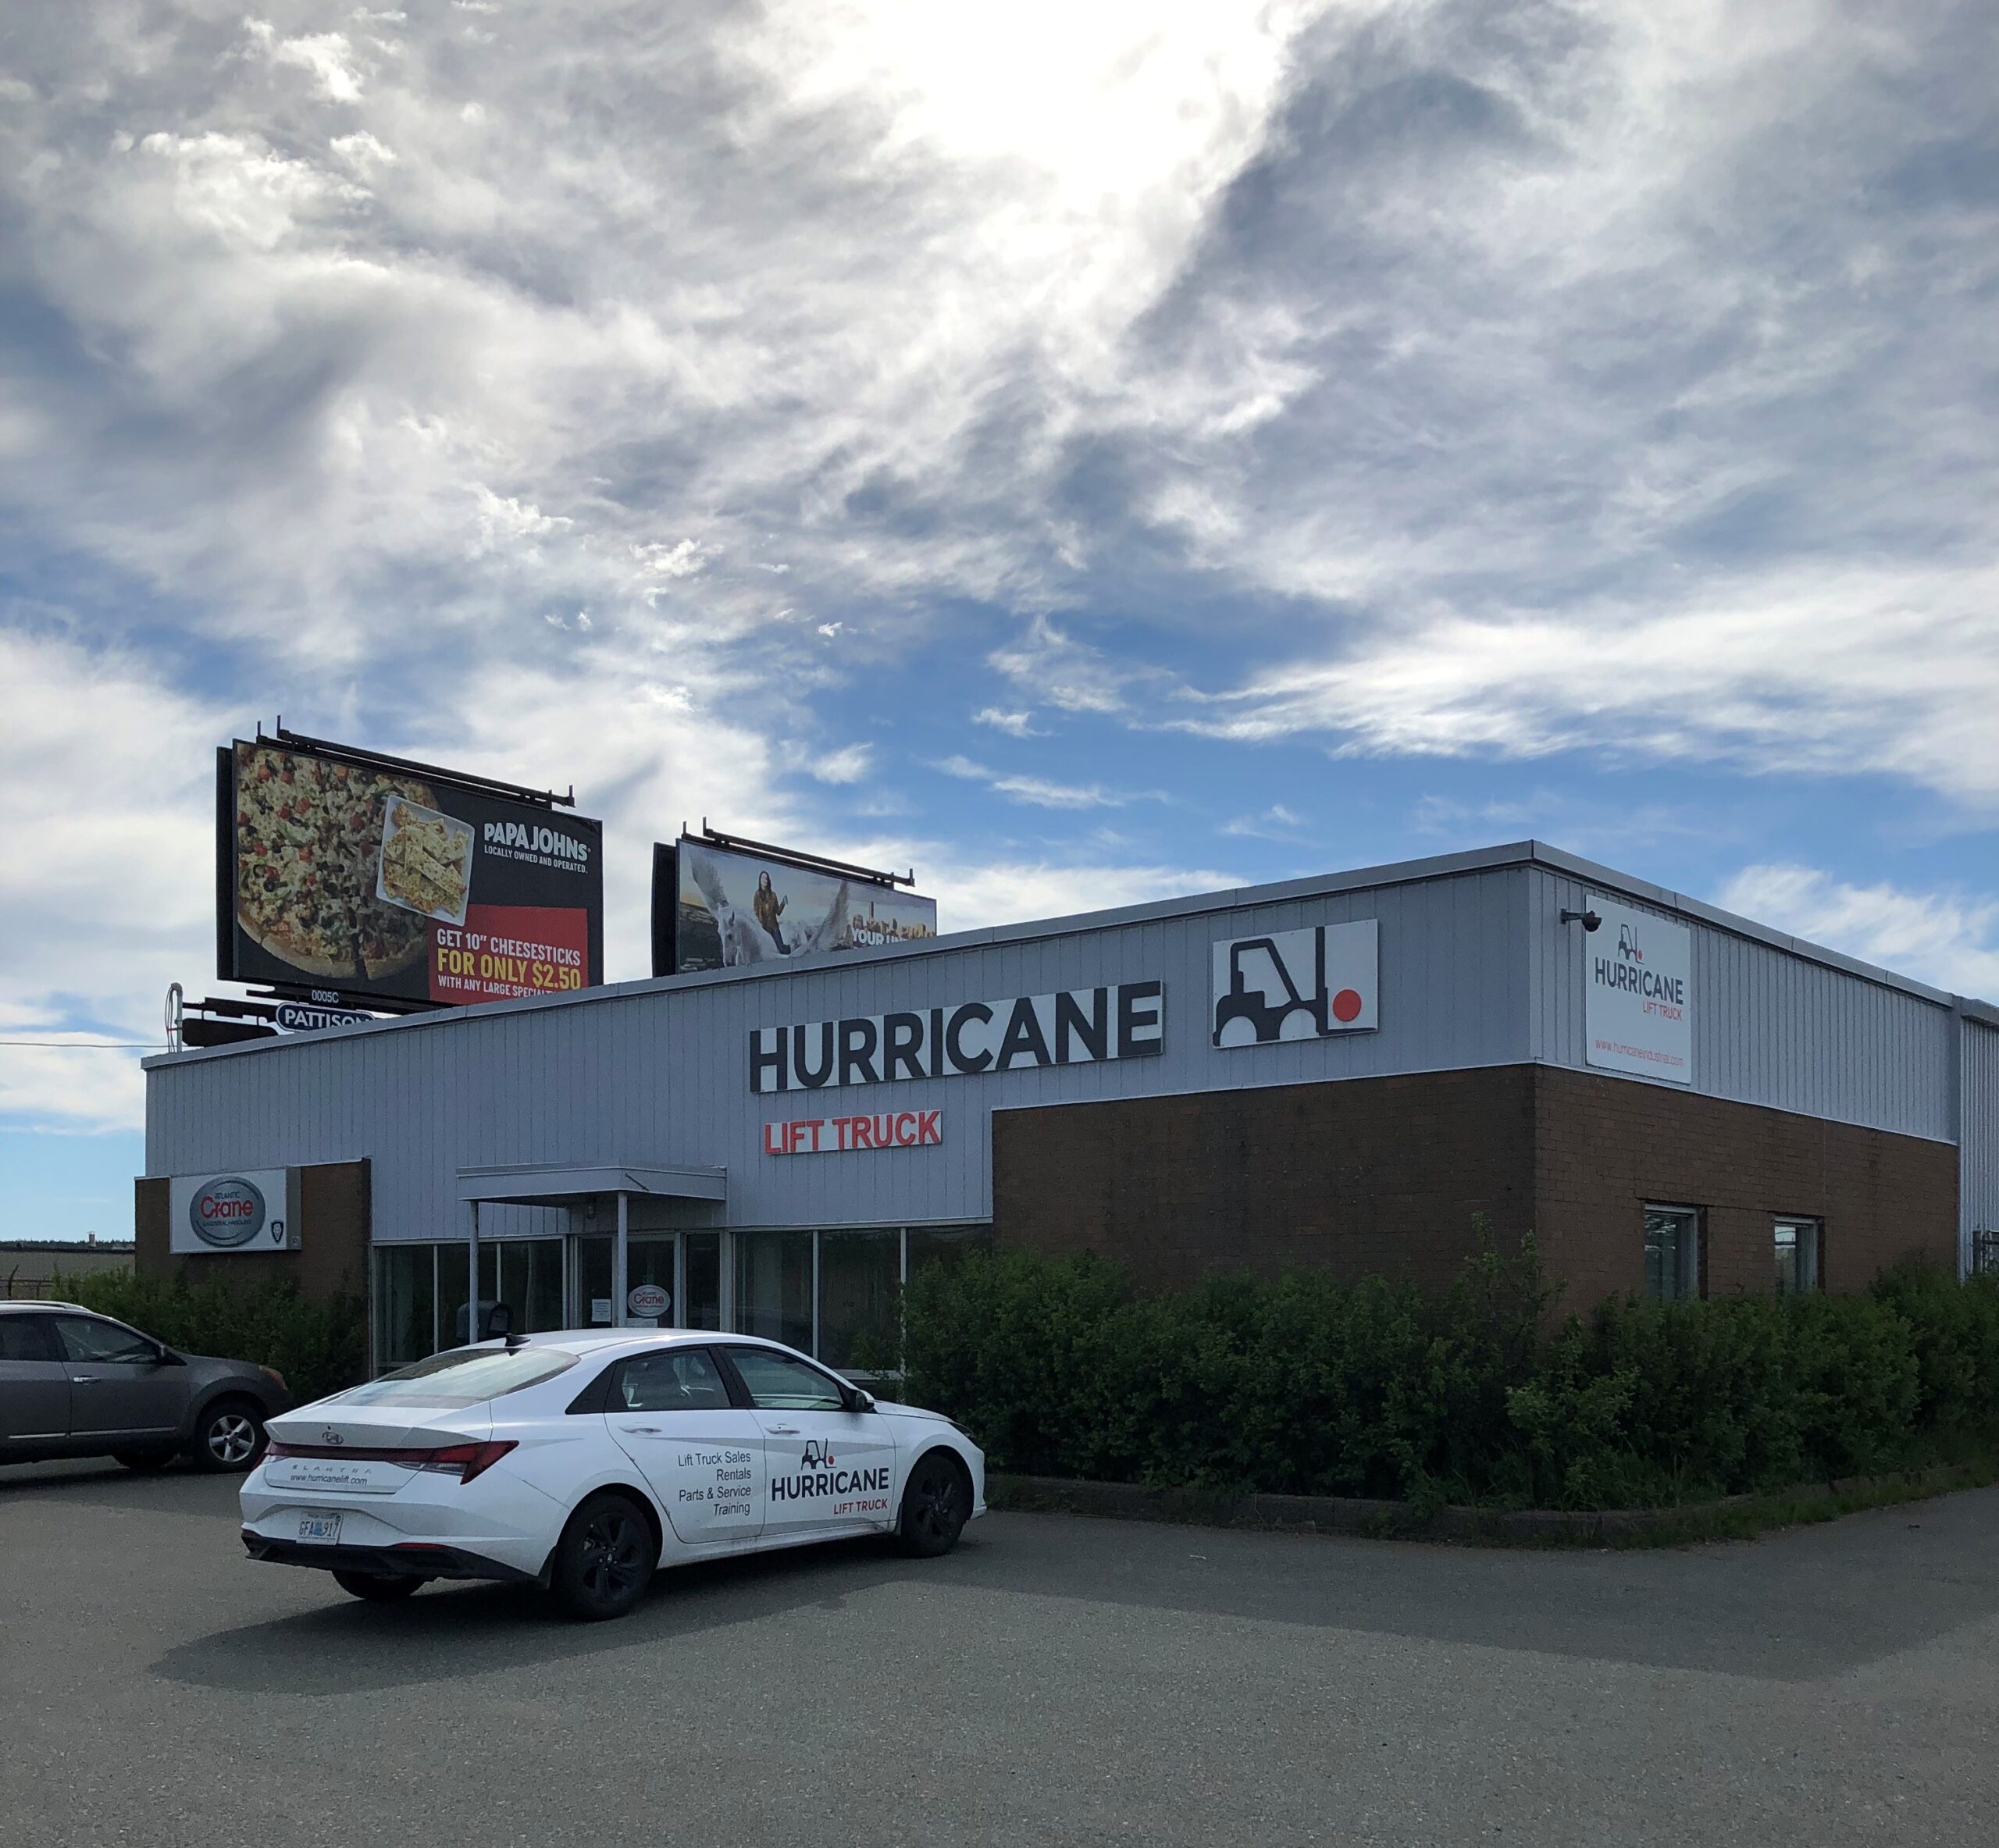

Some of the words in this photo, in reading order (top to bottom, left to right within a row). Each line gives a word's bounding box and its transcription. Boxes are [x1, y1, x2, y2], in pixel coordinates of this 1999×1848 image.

[484, 822, 530, 849] PAPA
[531, 826, 588, 861] JOHNS
[484, 845, 513, 858] LOCALLY
[514, 850, 538, 863] OWNED
[539, 856, 552, 867] AND
[553, 860, 588, 874] OPERATED.
[851, 927, 884, 945] YOUR
[437, 928, 462, 948] GET
[466, 932, 487, 950] 10"
[490, 936, 581, 966] CHEESESTICKS
[437, 947, 475, 976] FOR
[480, 954, 528, 984] ONLY
[532, 960, 581, 990] $2.50
[438, 974, 461, 989] WITH
[464, 979, 481, 992] ANY
[483, 981, 511, 995] LARGE
[512, 985, 557, 998] SPECIA
[1595, 956, 1684, 1005] HURRICANE
[312, 989, 339, 1003] 0005C
[284, 1009, 370, 1027] PATTISO
[1642, 1000, 1657, 1015] LIFT
[1659, 1004, 1683, 1021] TRUCK
[750, 980, 1162, 1092] HURRICANE
[764, 1120, 824, 1154] LIFT
[832, 1110, 942, 1150] TRUCK
[200, 1196, 253, 1218] Crane
[633, 1293, 665, 1304] Crane
[678, 1454, 693, 1467] Lift
[695, 1452, 722, 1465] Truck
[725, 1451, 751, 1463] Sales
[716, 1468, 751, 1481] Rentals
[771, 1467, 889, 1501] HURRICANE
[679, 1489, 704, 1502] Parts
[707, 1487, 714, 1499] &
[717, 1485, 751, 1498] Service
[714, 1501, 750, 1516] Training
[833, 1502, 854, 1515] LIFT
[856, 1498, 888, 1512] TRUCK
